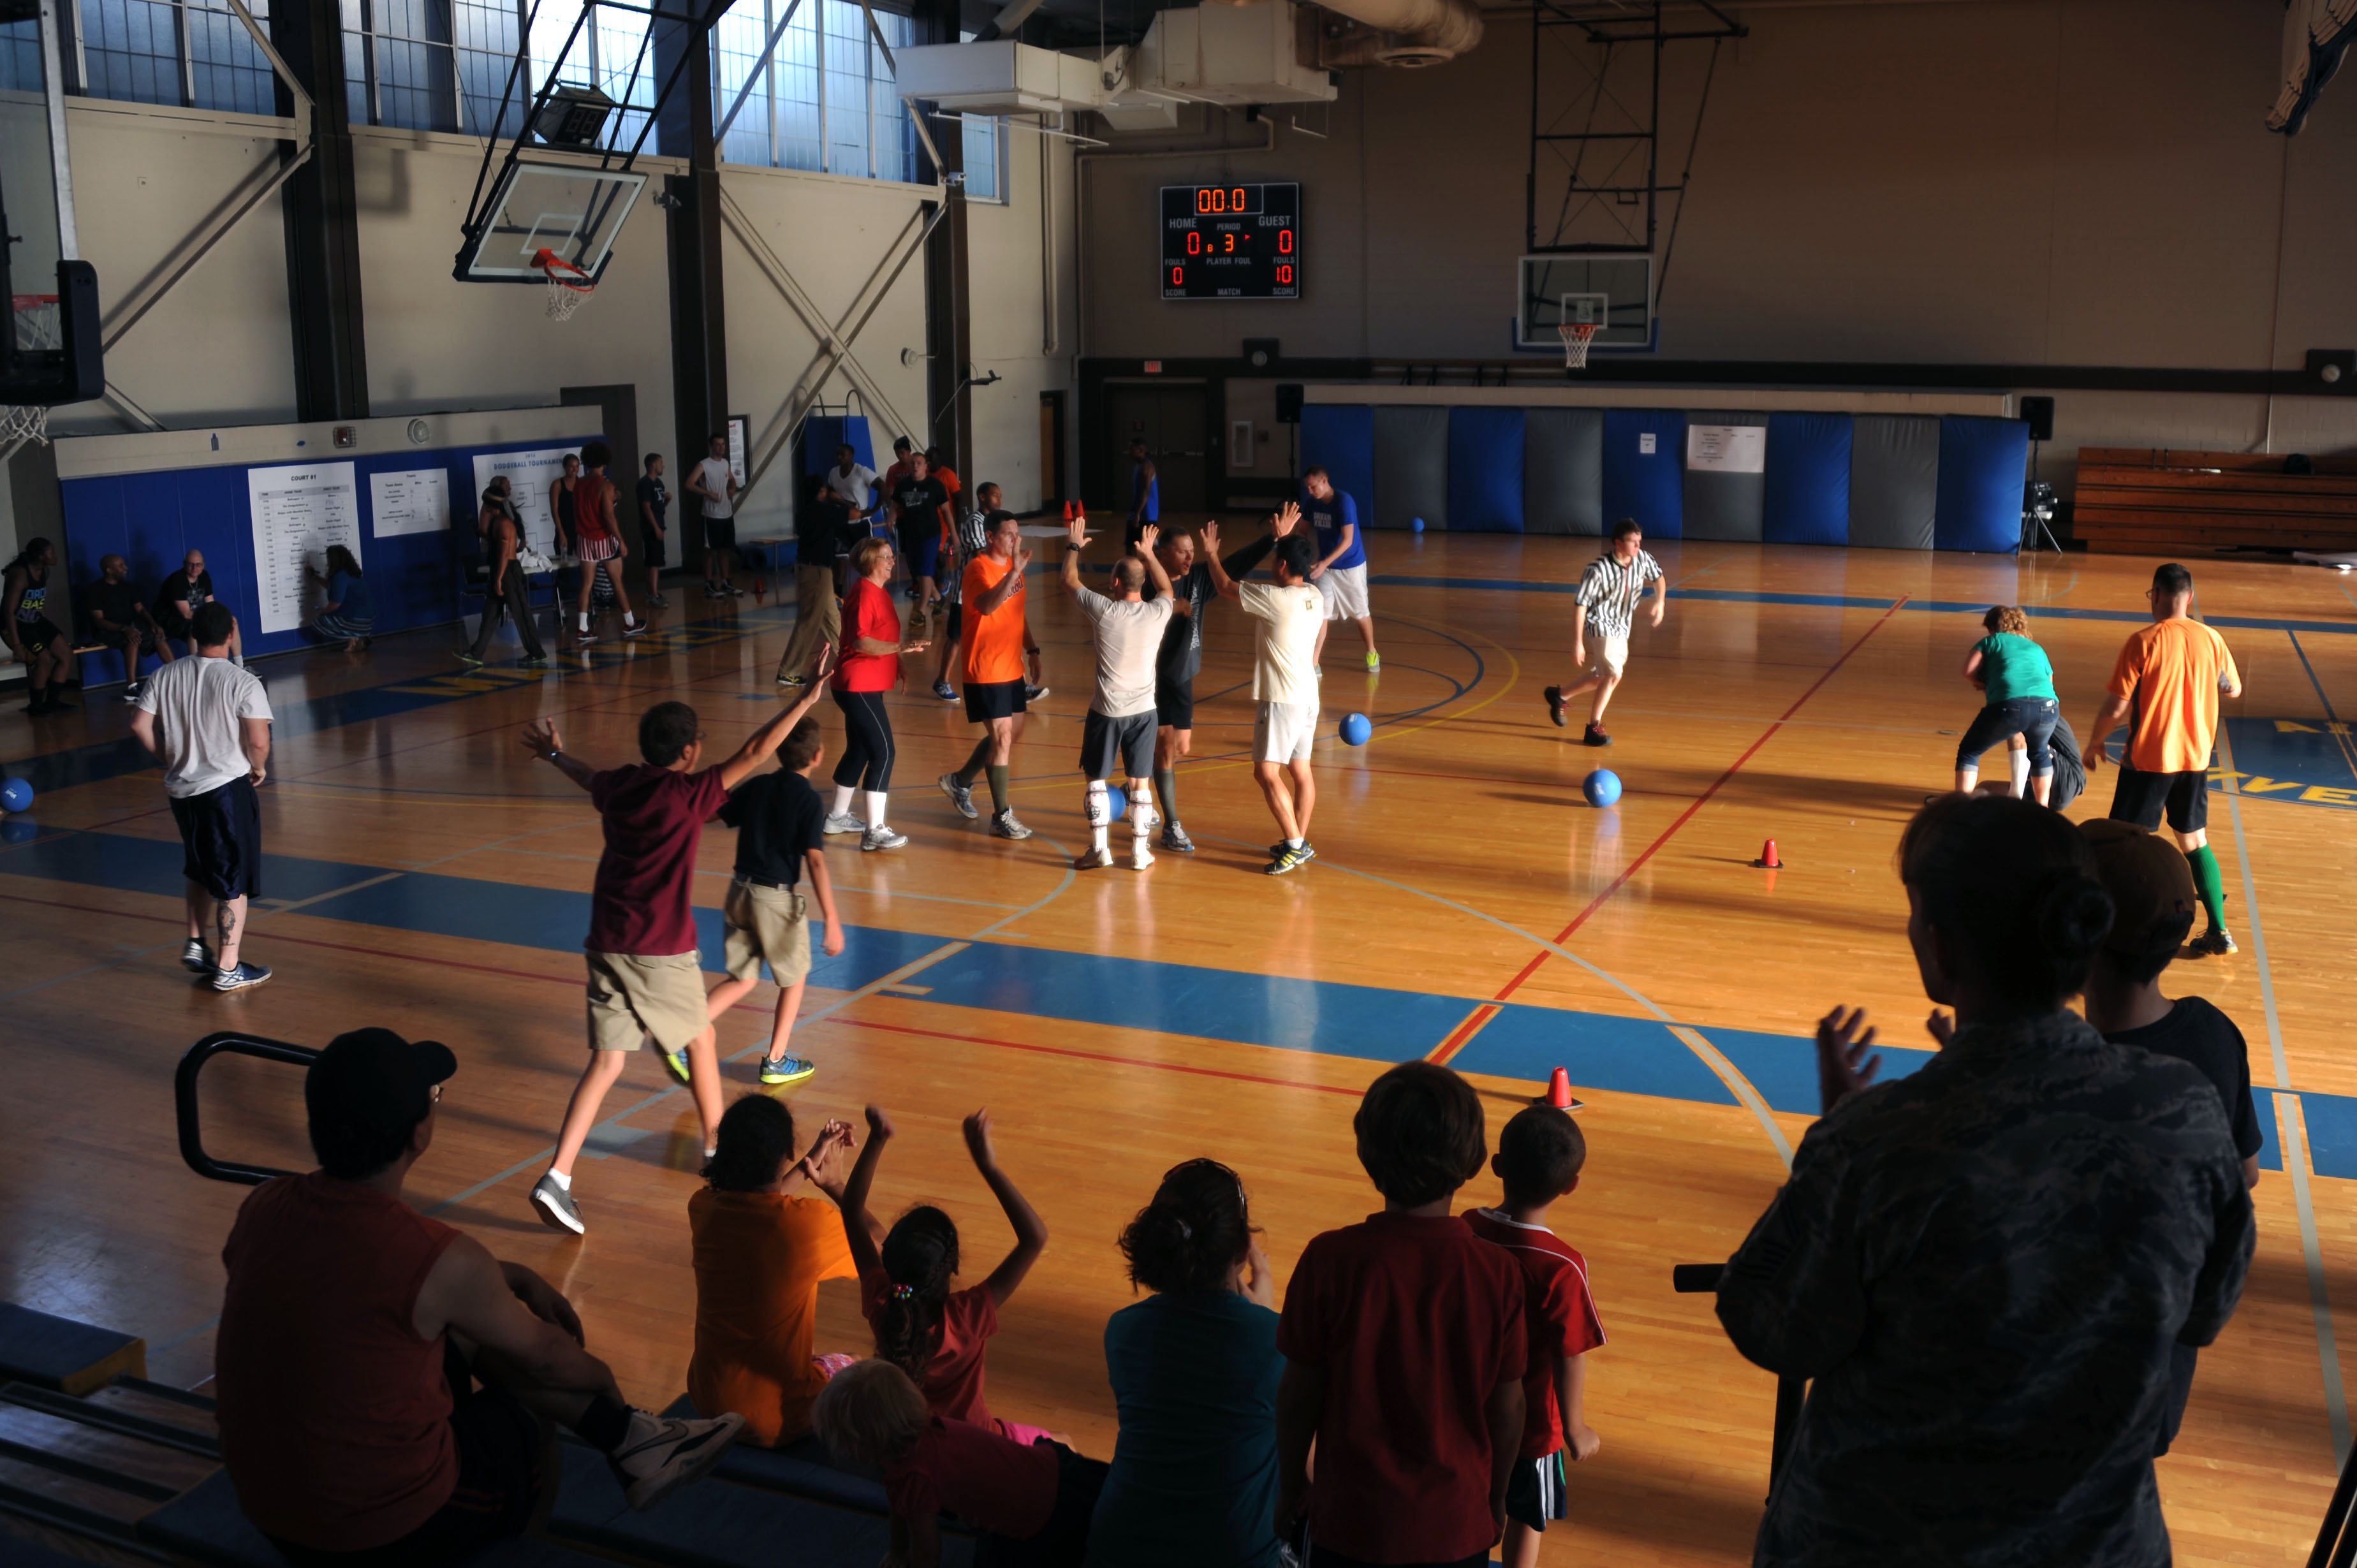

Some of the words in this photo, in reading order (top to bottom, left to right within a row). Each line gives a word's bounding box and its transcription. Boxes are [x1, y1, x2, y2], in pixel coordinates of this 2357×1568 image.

[1199, 188, 1245, 212] 00.0
[1170, 218, 1197, 229] HOME
[1258, 216, 1291, 226] GUEST
[1187, 231, 1200, 255] 0
[1224, 233, 1234, 252] 3
[1279, 230, 1293, 253] 0
[1173, 267, 1183, 285] 0
[1276, 265, 1292, 284] 10
[494, 461, 527, 470] DODGEBALL
[528, 458, 562, 467] TOURNAMEN
